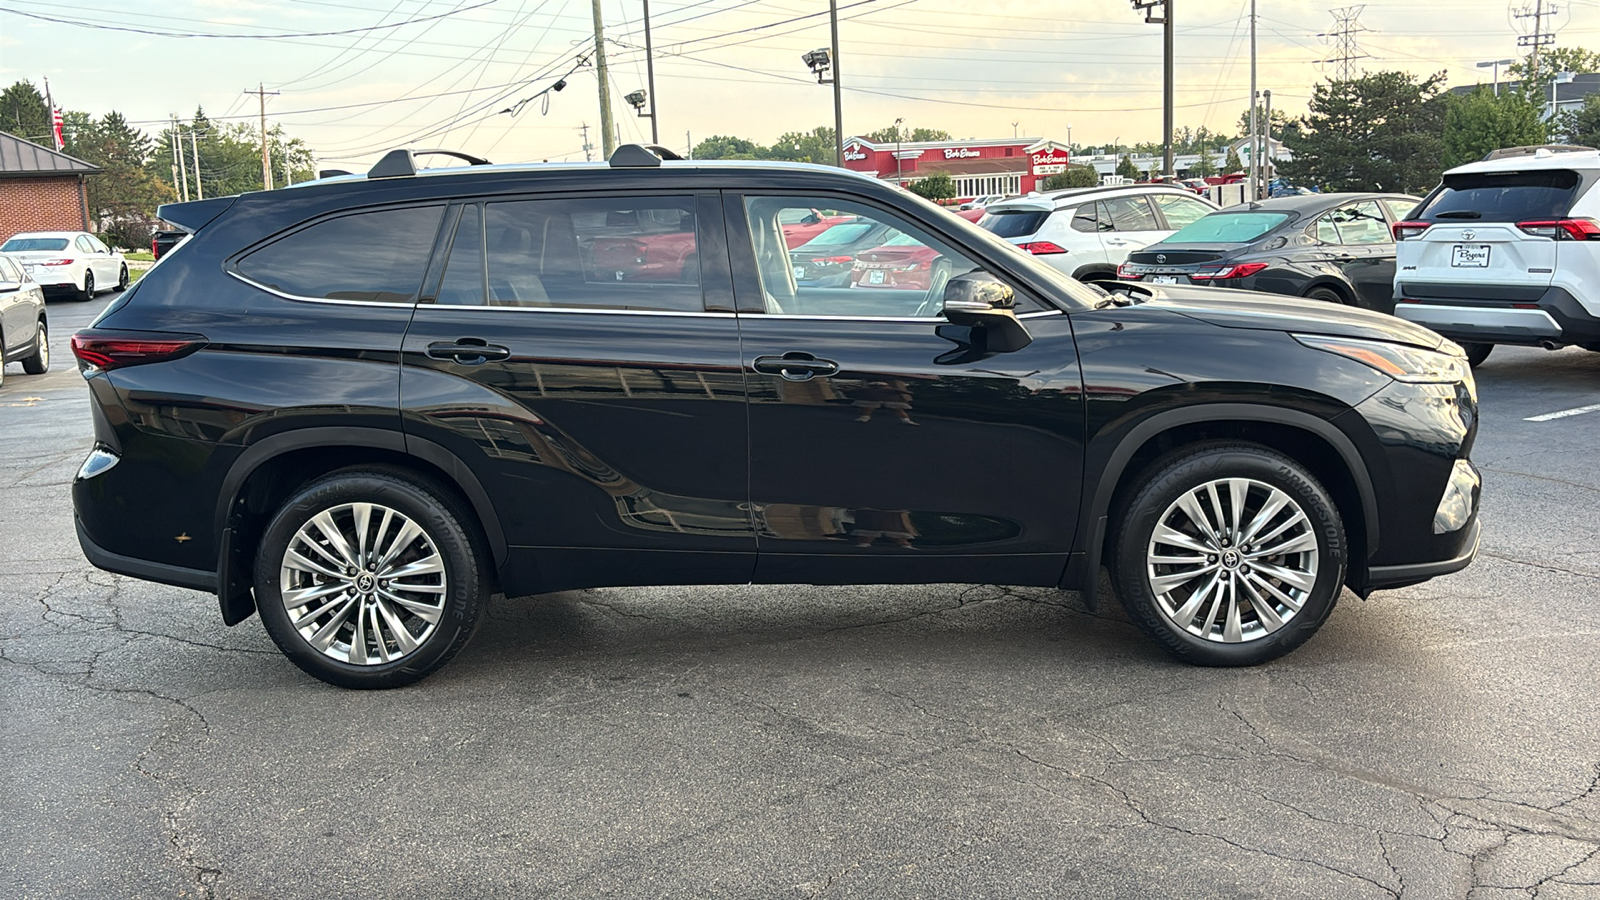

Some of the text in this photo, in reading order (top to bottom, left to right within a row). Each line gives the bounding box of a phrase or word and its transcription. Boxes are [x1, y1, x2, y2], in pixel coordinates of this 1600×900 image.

[943, 148, 980, 159] Bob Evans
[1032, 154, 1047, 164] Bob
[1456, 249, 1486, 261] Byers
[1276, 465, 1341, 557] BRIDGESTONE
